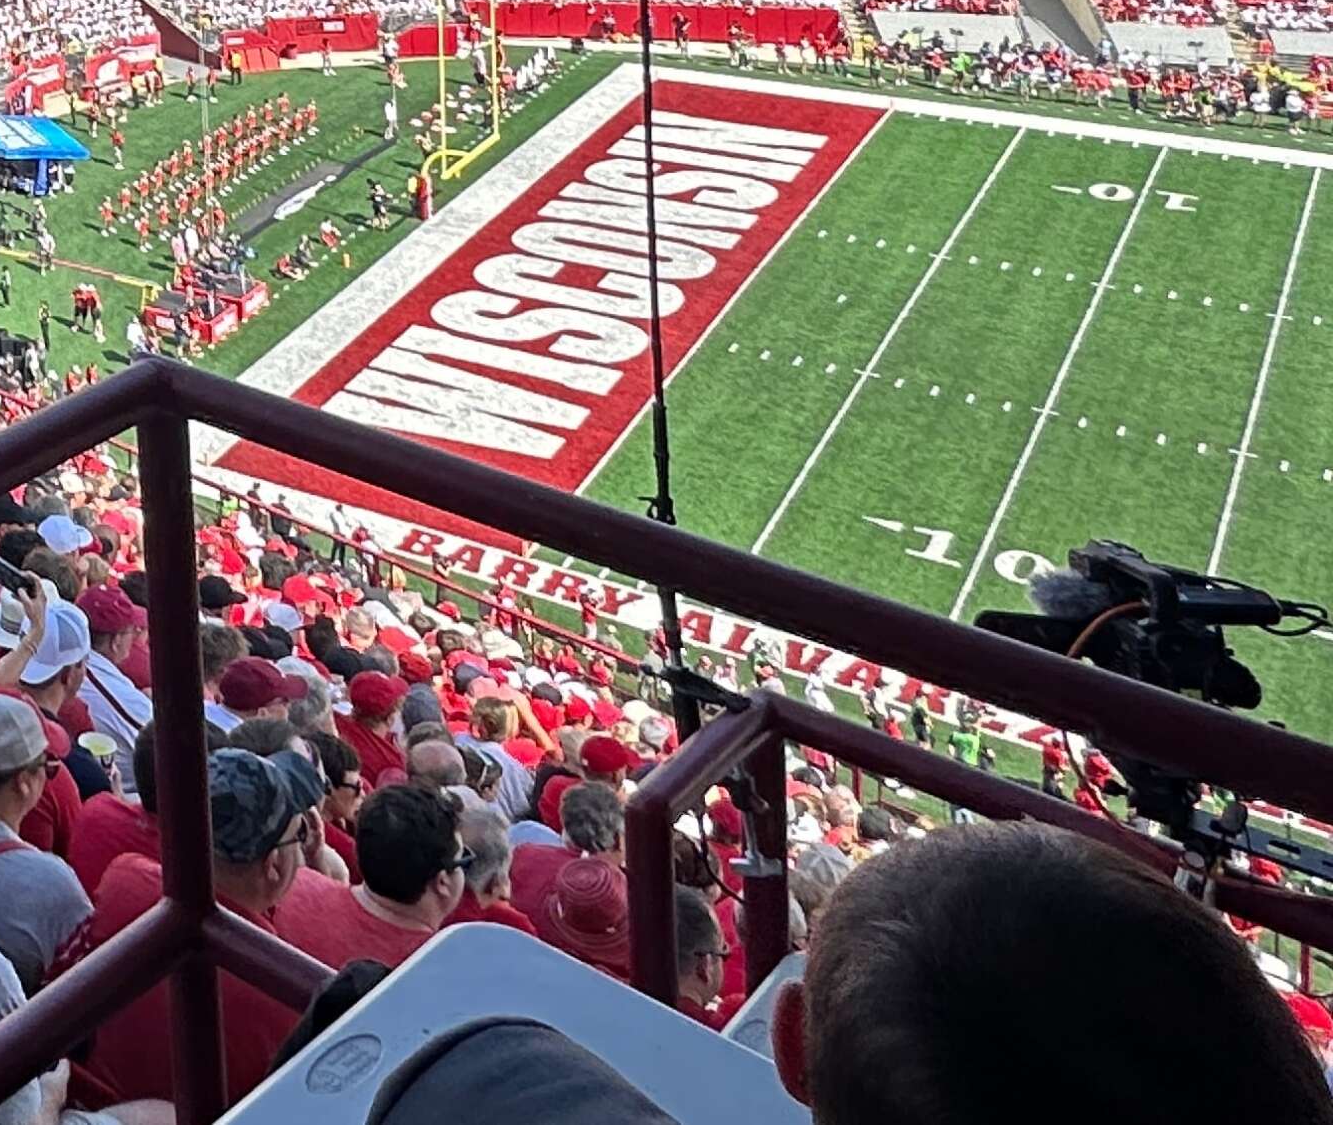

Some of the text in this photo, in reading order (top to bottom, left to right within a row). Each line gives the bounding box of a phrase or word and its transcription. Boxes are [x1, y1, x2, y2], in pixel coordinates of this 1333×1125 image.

[1086, 182, 1201, 213] 10
[320, 110, 830, 461] WISCONSIN
[395, 527, 645, 616] BARRY
